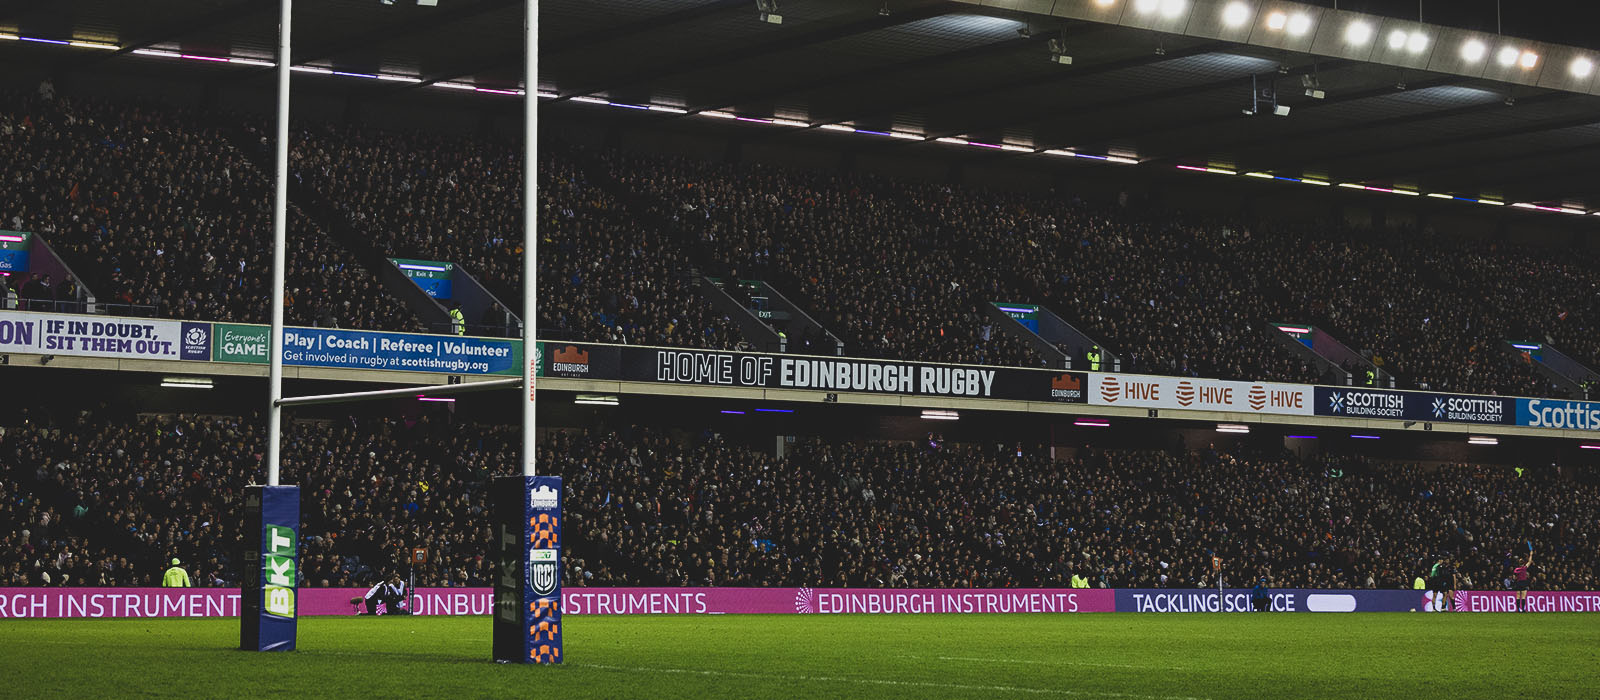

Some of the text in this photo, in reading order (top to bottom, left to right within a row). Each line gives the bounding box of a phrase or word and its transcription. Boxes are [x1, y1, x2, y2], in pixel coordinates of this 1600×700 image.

[0, 320, 34, 345] ON
[46, 320, 158, 341] IF IN DOUBT,
[224, 331, 266, 344] Everyone's
[46, 336, 176, 355] SIT THEM OUT.
[224, 342, 266, 356] GAME
[284, 332, 509, 357] Play Coach Referee Volunteer
[283, 350, 489, 372] Get involved in rugby at scottishrugby.org
[553, 362, 589, 372] EDINBURGH
[657, 351, 995, 396] HOME OF EDINBURGH RUGBY
[1125, 382, 1160, 401] HIVE
[1199, 386, 1233, 405] HIVE
[1270, 391, 1303, 408] HIVE
[1346, 392, 1404, 409] SCOTTISH
[1346, 407, 1404, 417] BUILDING SOCIETY
[1448, 397, 1502, 414] SCOTTISH
[1448, 413, 1502, 422] BUILDING SOCIETY
[270, 527, 291, 614] BKT
[58, 594, 241, 617] INSTRUMENT
[818, 593, 1078, 613] EDINBURGH INSTRUMENTS
[1133, 594, 1295, 612] TACKLING SCICE
[1471, 595, 1555, 612] EDINBRGH
